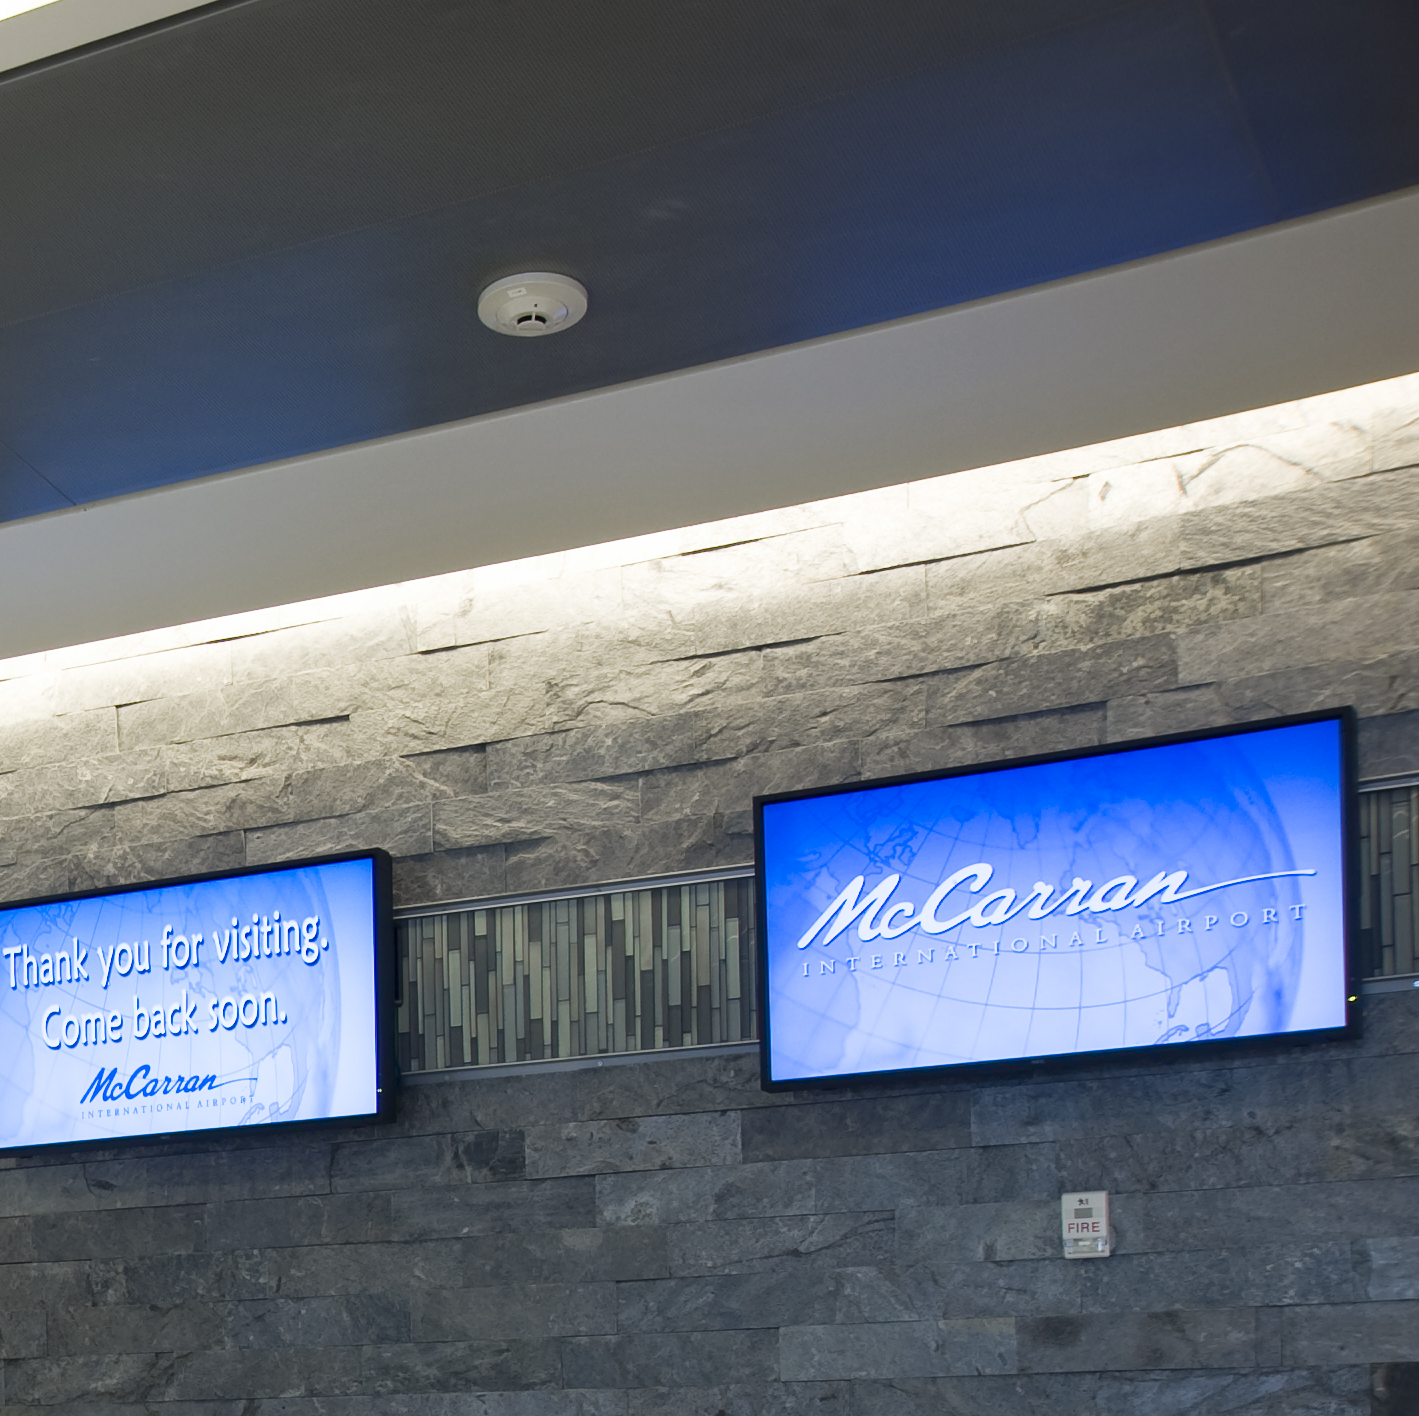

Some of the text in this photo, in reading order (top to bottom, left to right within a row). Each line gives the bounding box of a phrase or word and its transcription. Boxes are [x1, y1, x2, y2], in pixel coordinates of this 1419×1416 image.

[797, 863, 1316, 950] McCarran
[3, 910, 329, 990] Thank you for visiting.
[803, 903, 1310, 977] INTERNATIONAL AIRPORT
[41, 990, 287, 1050] Come back soon.
[80, 1064, 257, 1104] McCarran
[82, 1096, 254, 1119] INTERNATIONAL AIRPORT
[1068, 1221, 1101, 1233] FIRE
